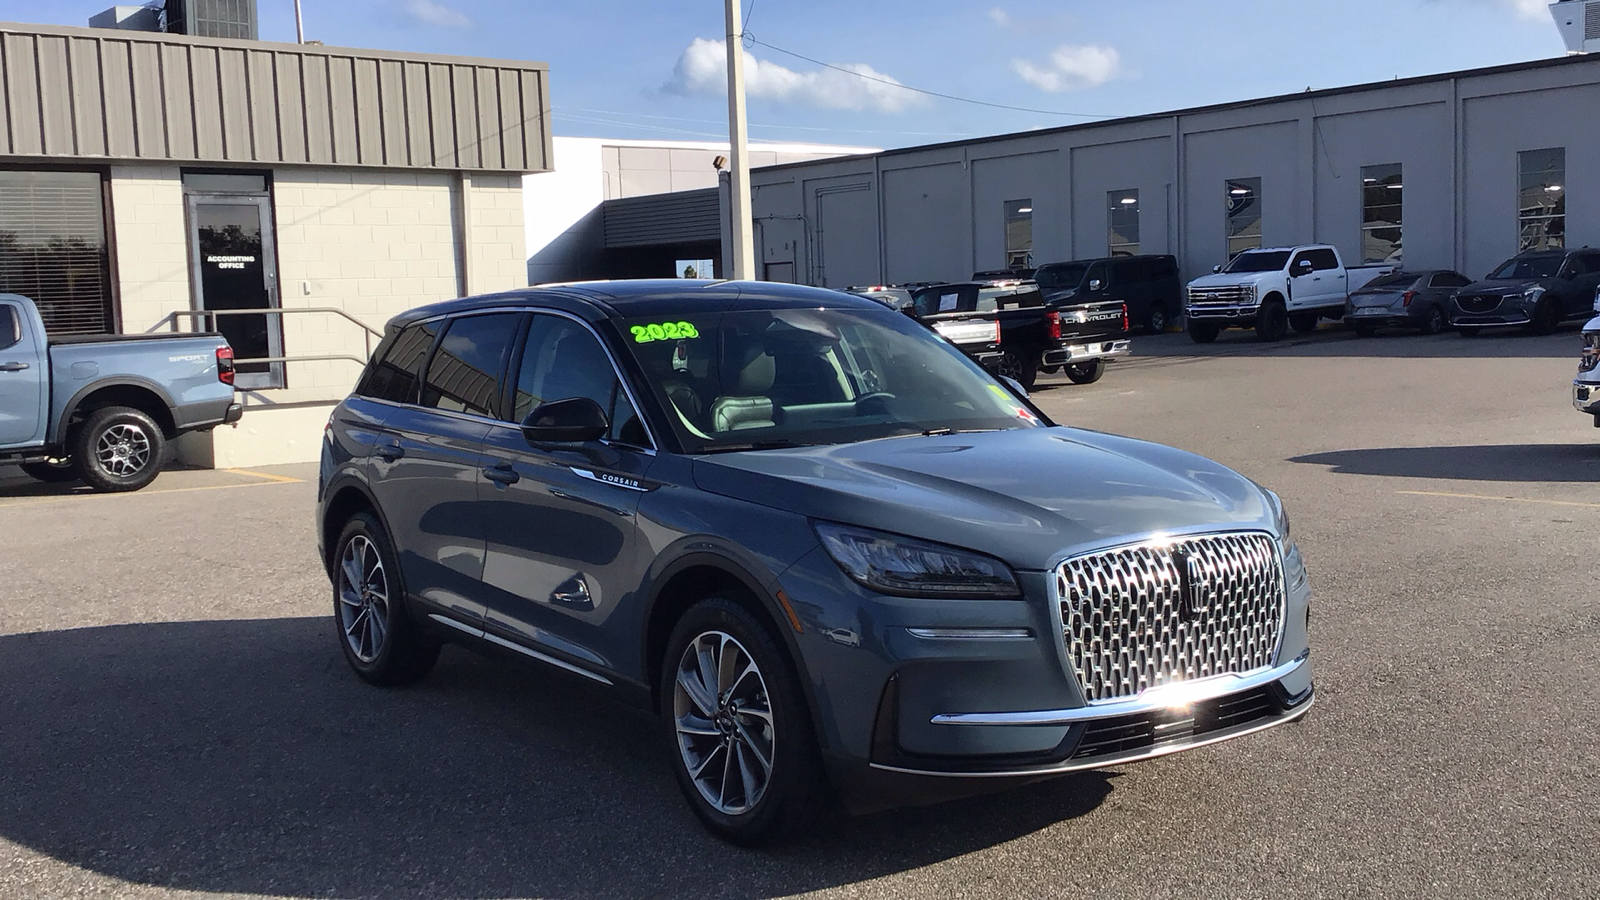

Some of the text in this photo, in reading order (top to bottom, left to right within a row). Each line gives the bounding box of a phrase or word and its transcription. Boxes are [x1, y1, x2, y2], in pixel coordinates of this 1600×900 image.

[1065, 313, 1122, 324] CHVROLET
[630, 321, 699, 343] 2023
[168, 354, 210, 362] SPORT
[602, 473, 639, 487] CORSAIR
